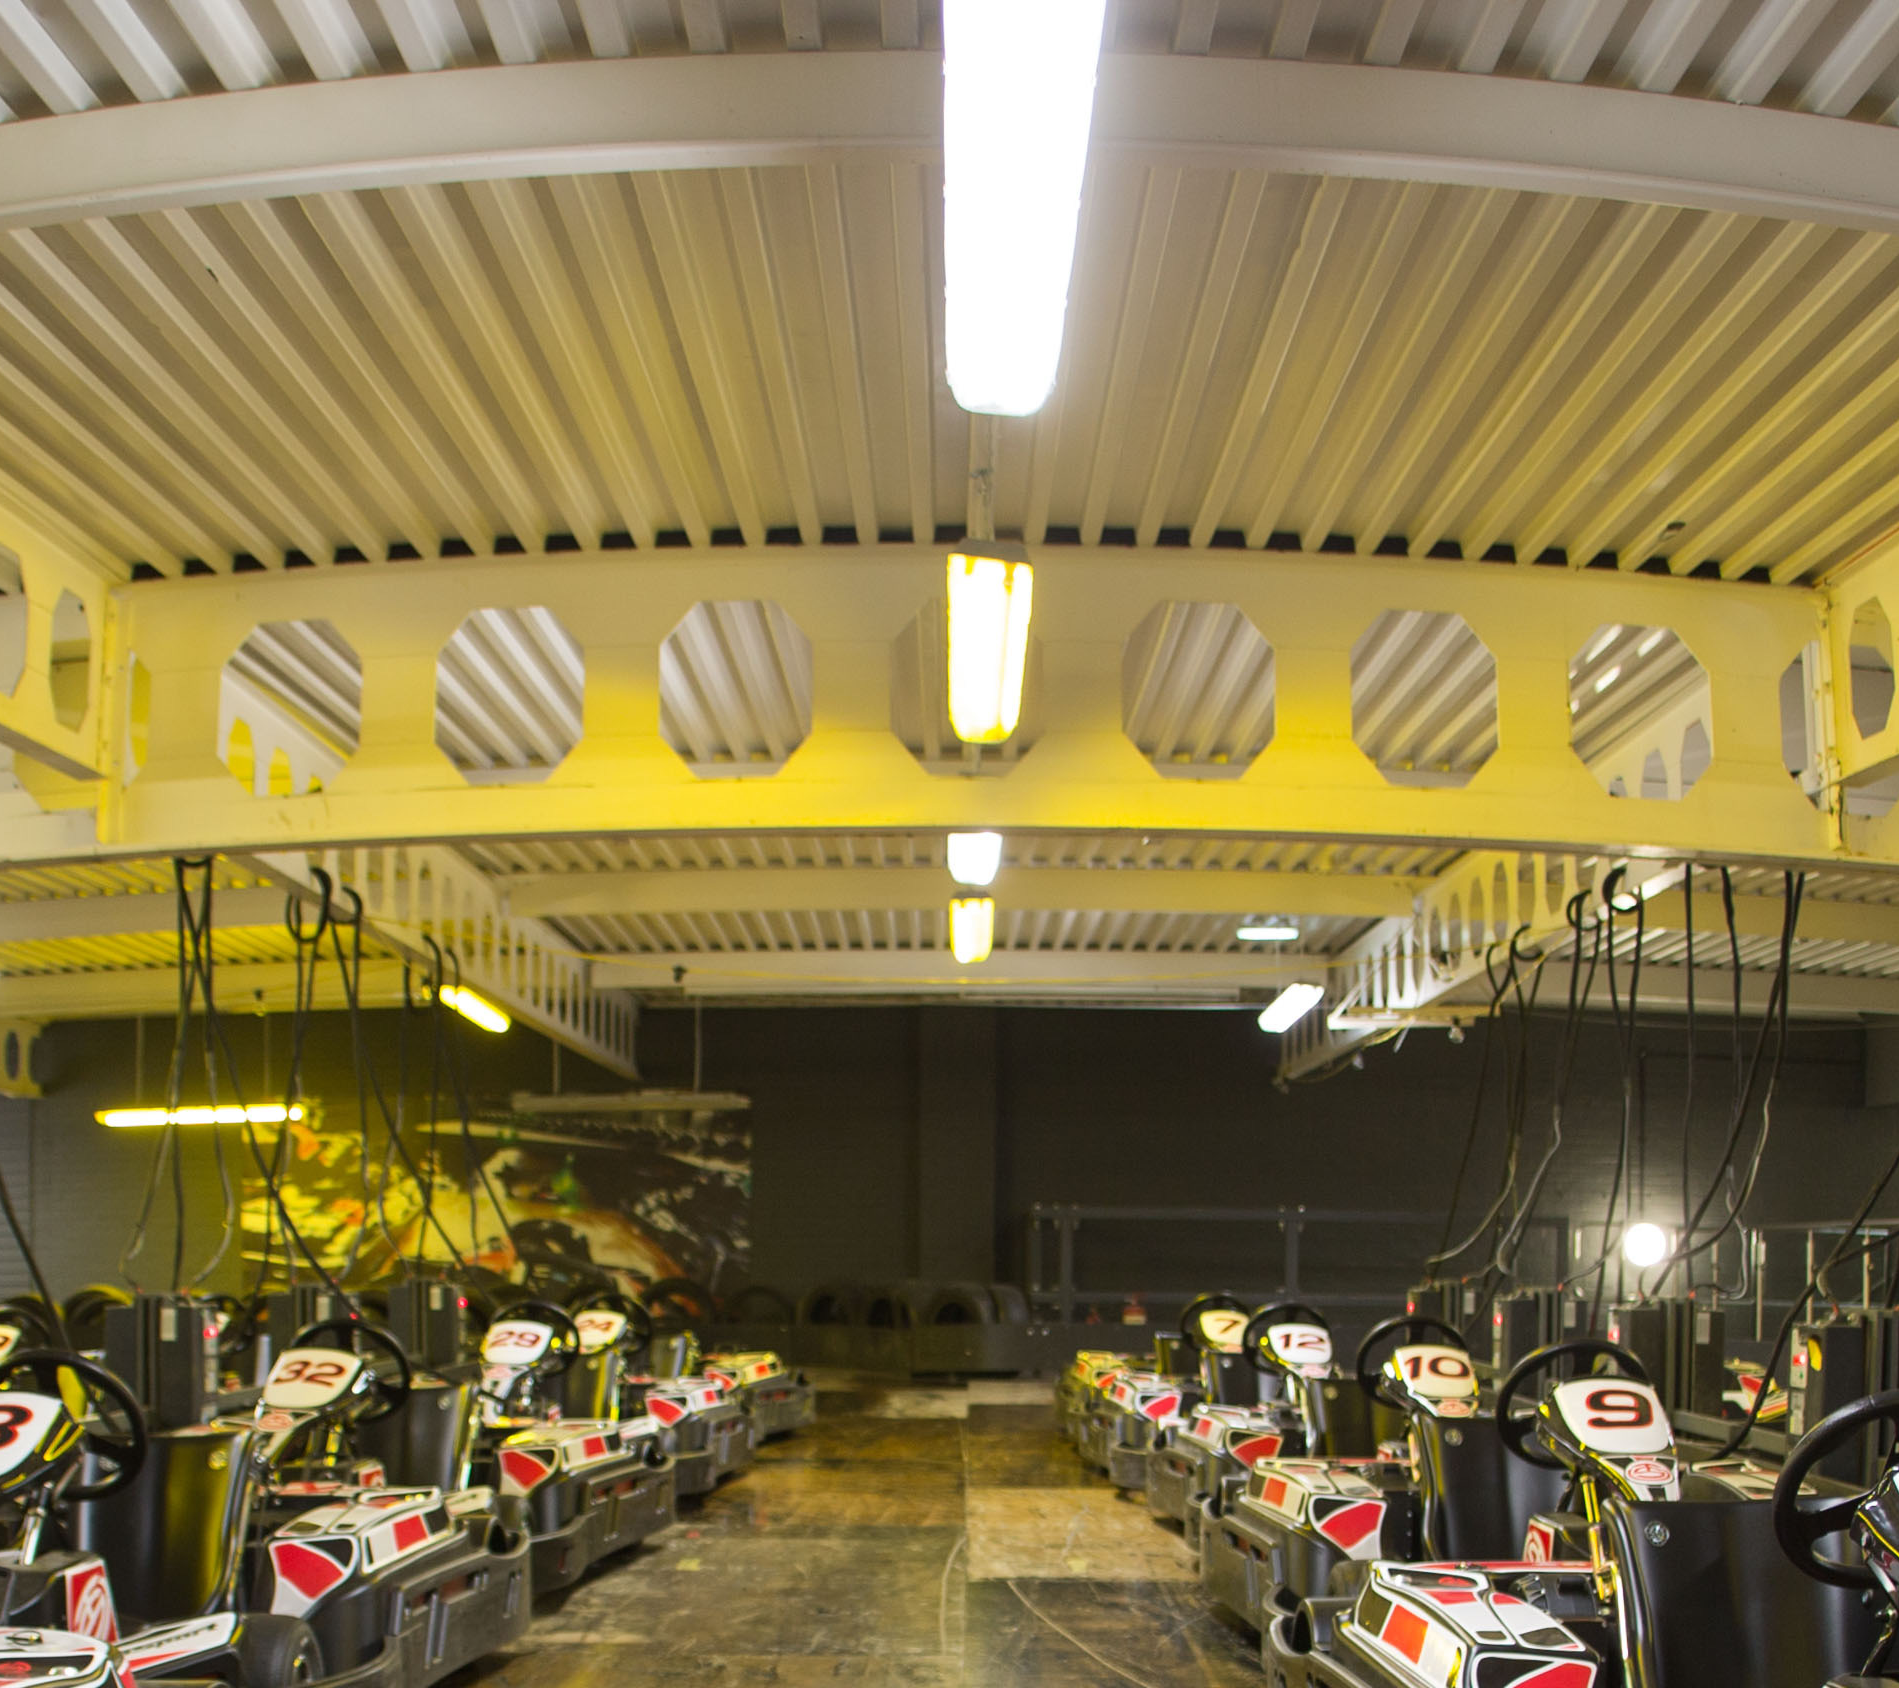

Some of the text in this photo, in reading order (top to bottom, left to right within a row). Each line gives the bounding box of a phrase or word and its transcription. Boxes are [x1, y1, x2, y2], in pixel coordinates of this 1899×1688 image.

[1280, 1332, 1328, 1351] 12
[271, 1359, 347, 1388] 32
[1404, 1354, 1472, 1381] 10
[1585, 1388, 1655, 1431] 9
